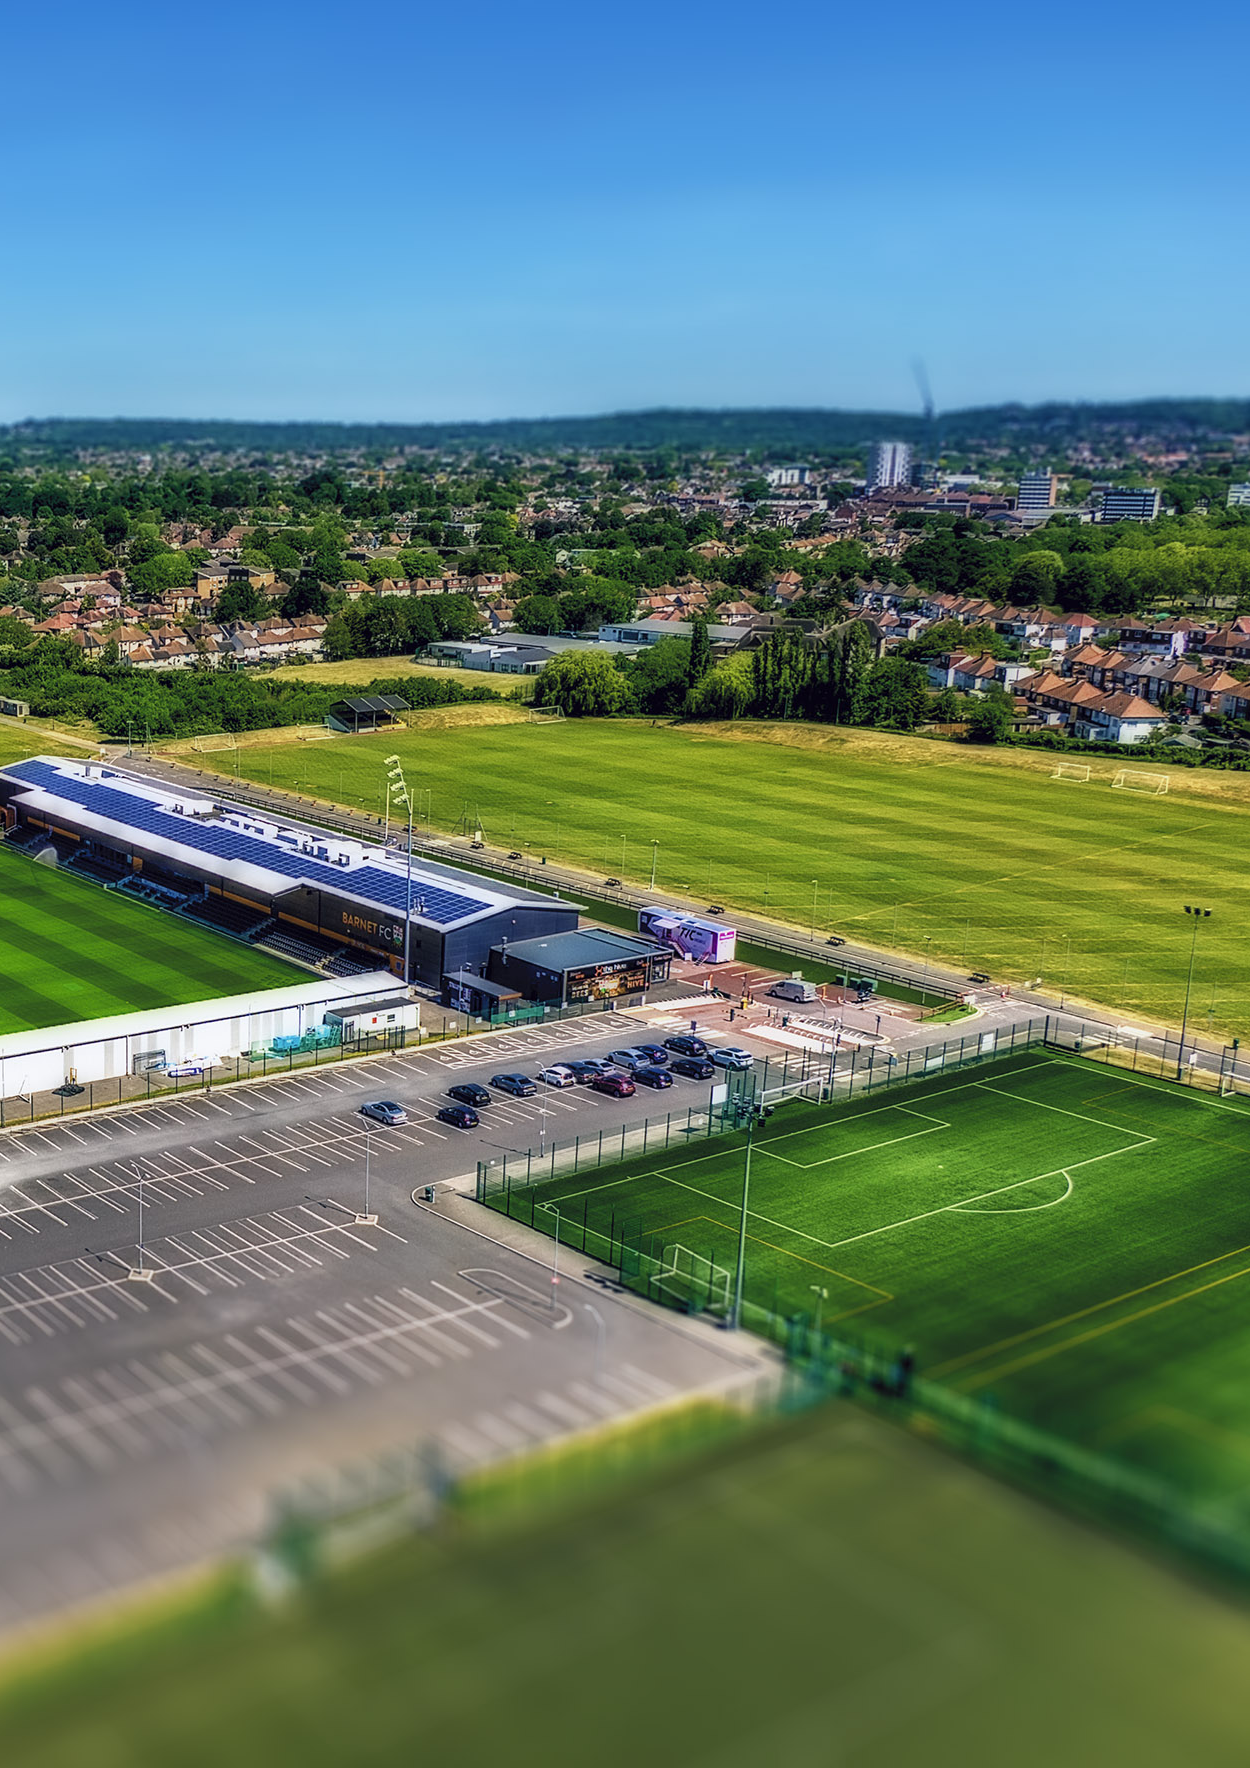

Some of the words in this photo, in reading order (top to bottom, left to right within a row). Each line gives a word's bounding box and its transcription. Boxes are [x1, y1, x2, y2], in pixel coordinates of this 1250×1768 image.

[342, 911, 378, 935] BARNET
[379, 925, 392, 940] FC
[627, 979, 644, 989] HIVE
